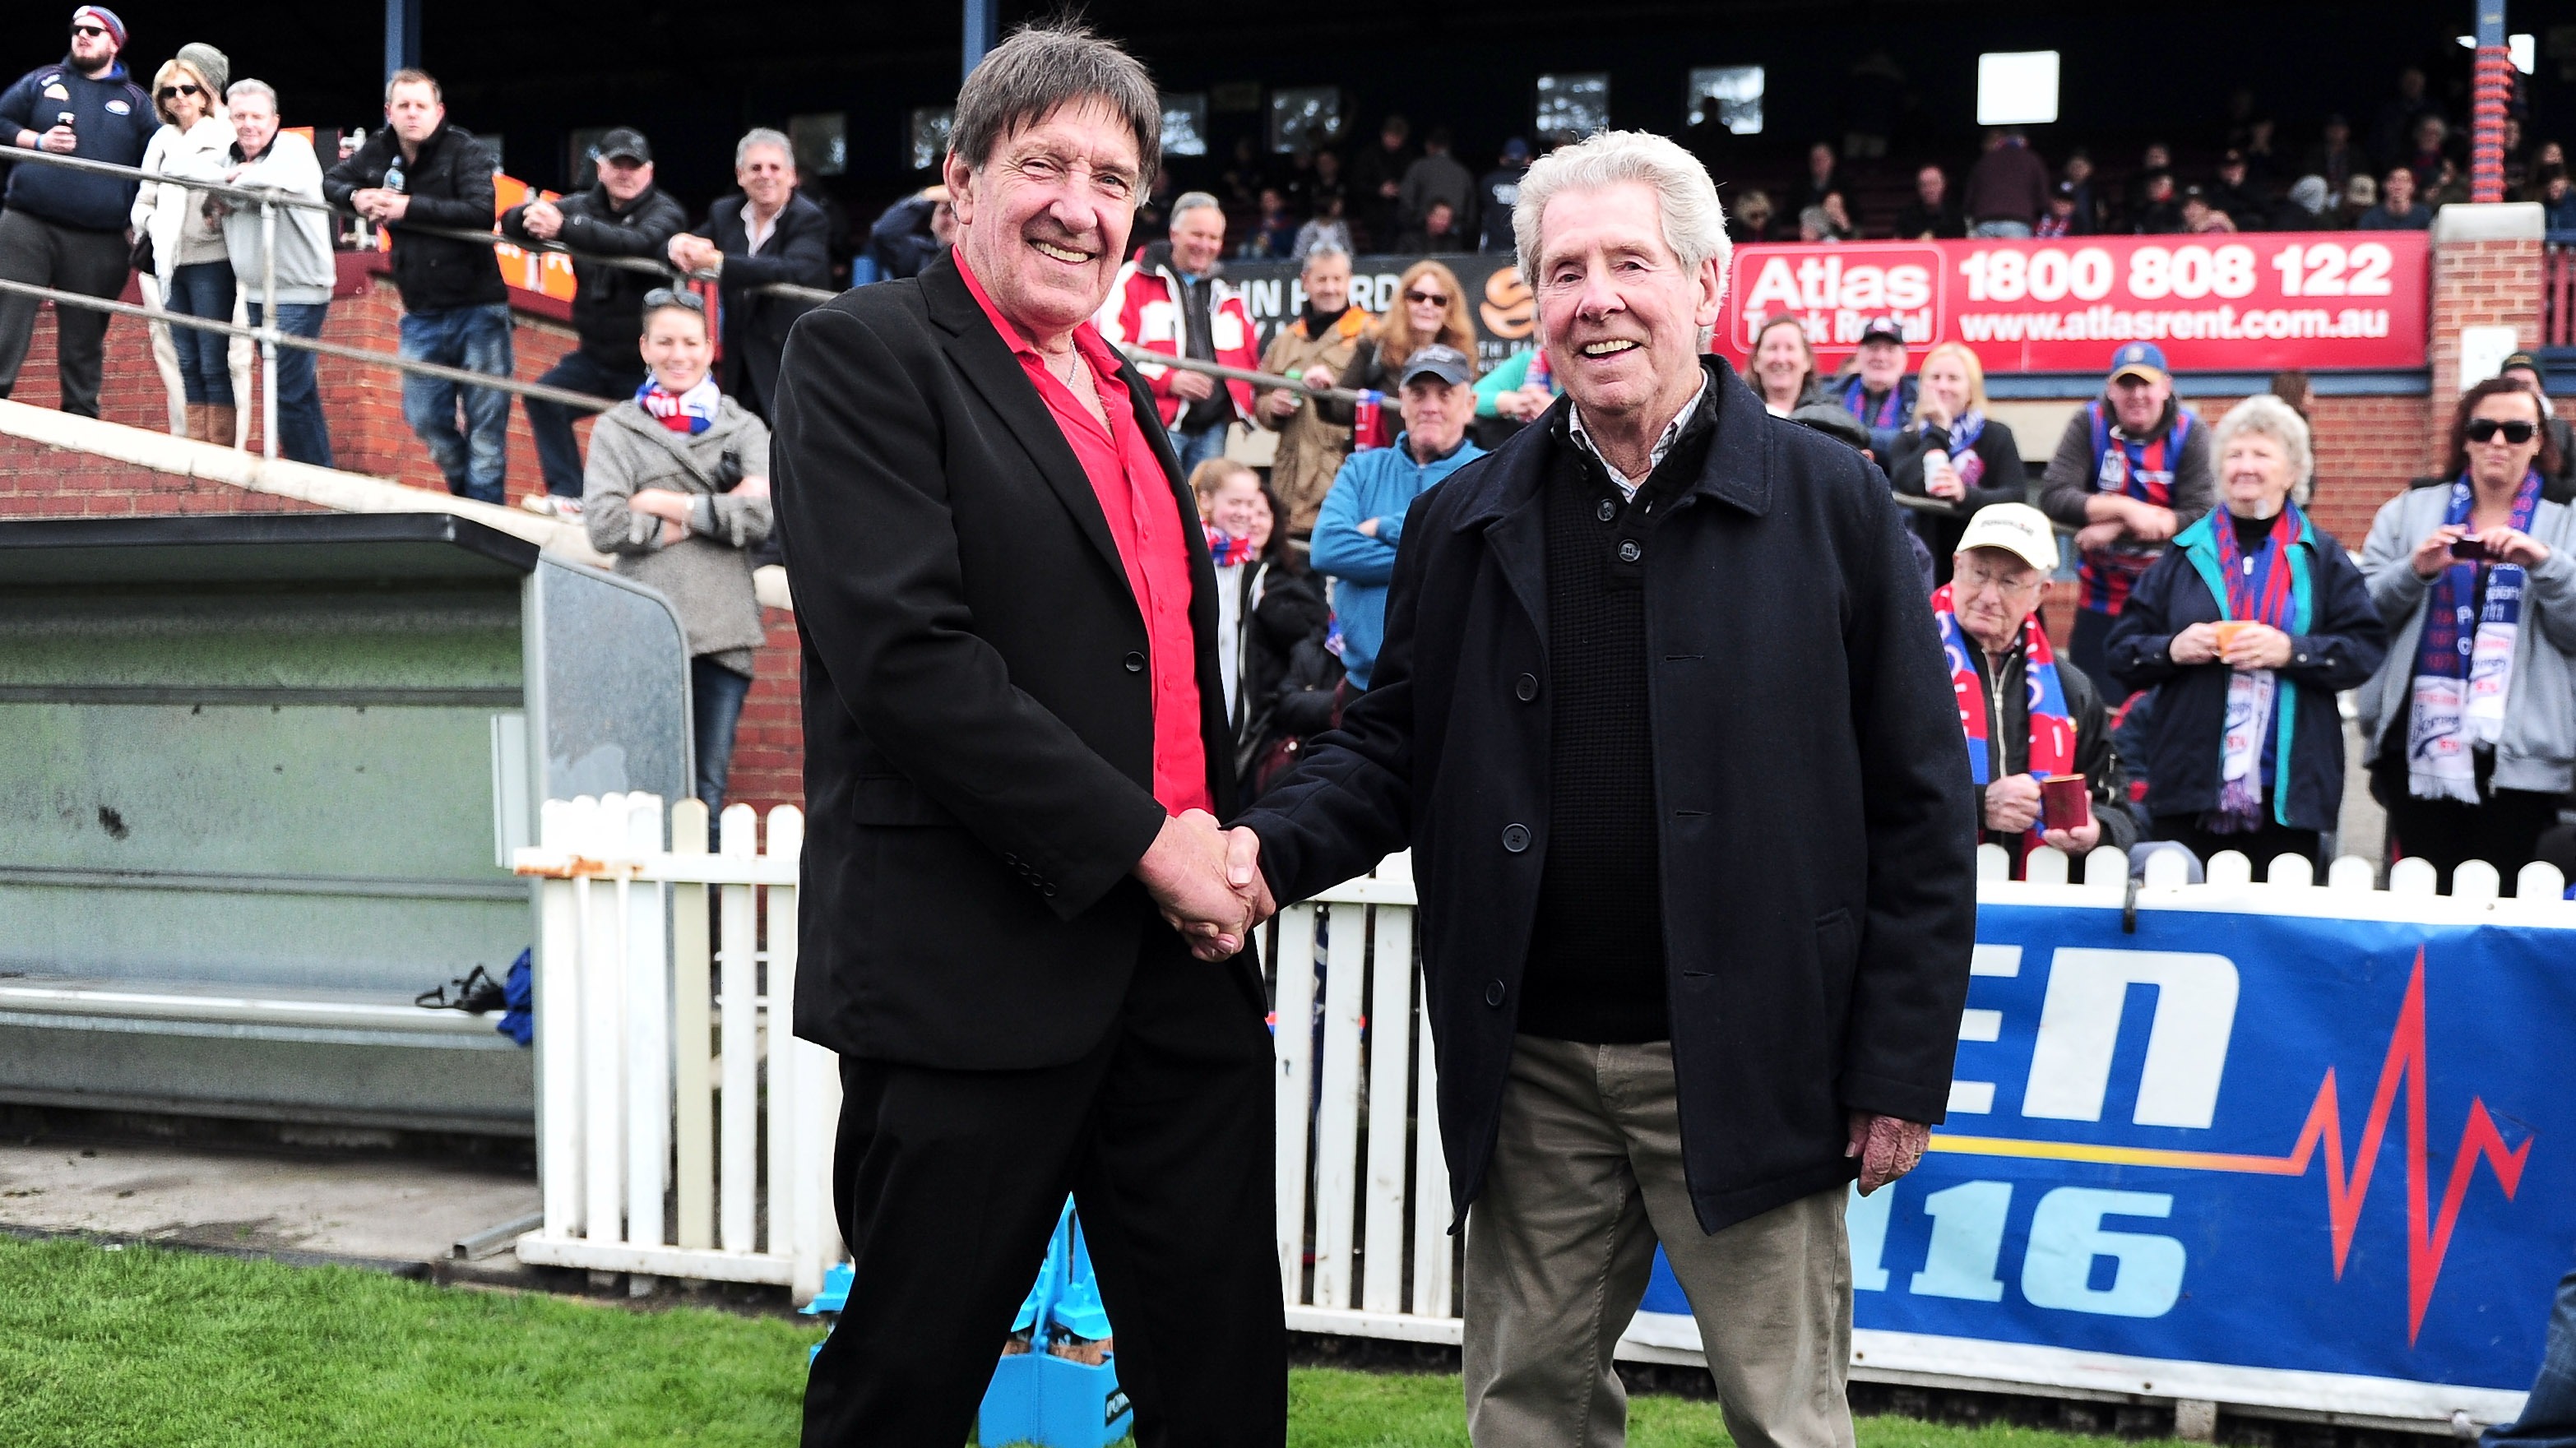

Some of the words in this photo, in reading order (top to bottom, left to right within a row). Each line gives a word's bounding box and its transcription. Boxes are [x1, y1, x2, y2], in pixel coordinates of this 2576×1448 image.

[1744, 256, 1930, 311] Atlas
[1959, 249, 2115, 302] 1800
[2128, 245, 2257, 299] 808
[2272, 242, 2393, 297] 122
[1958, 304, 2389, 342] www.atlasrent.com.au
